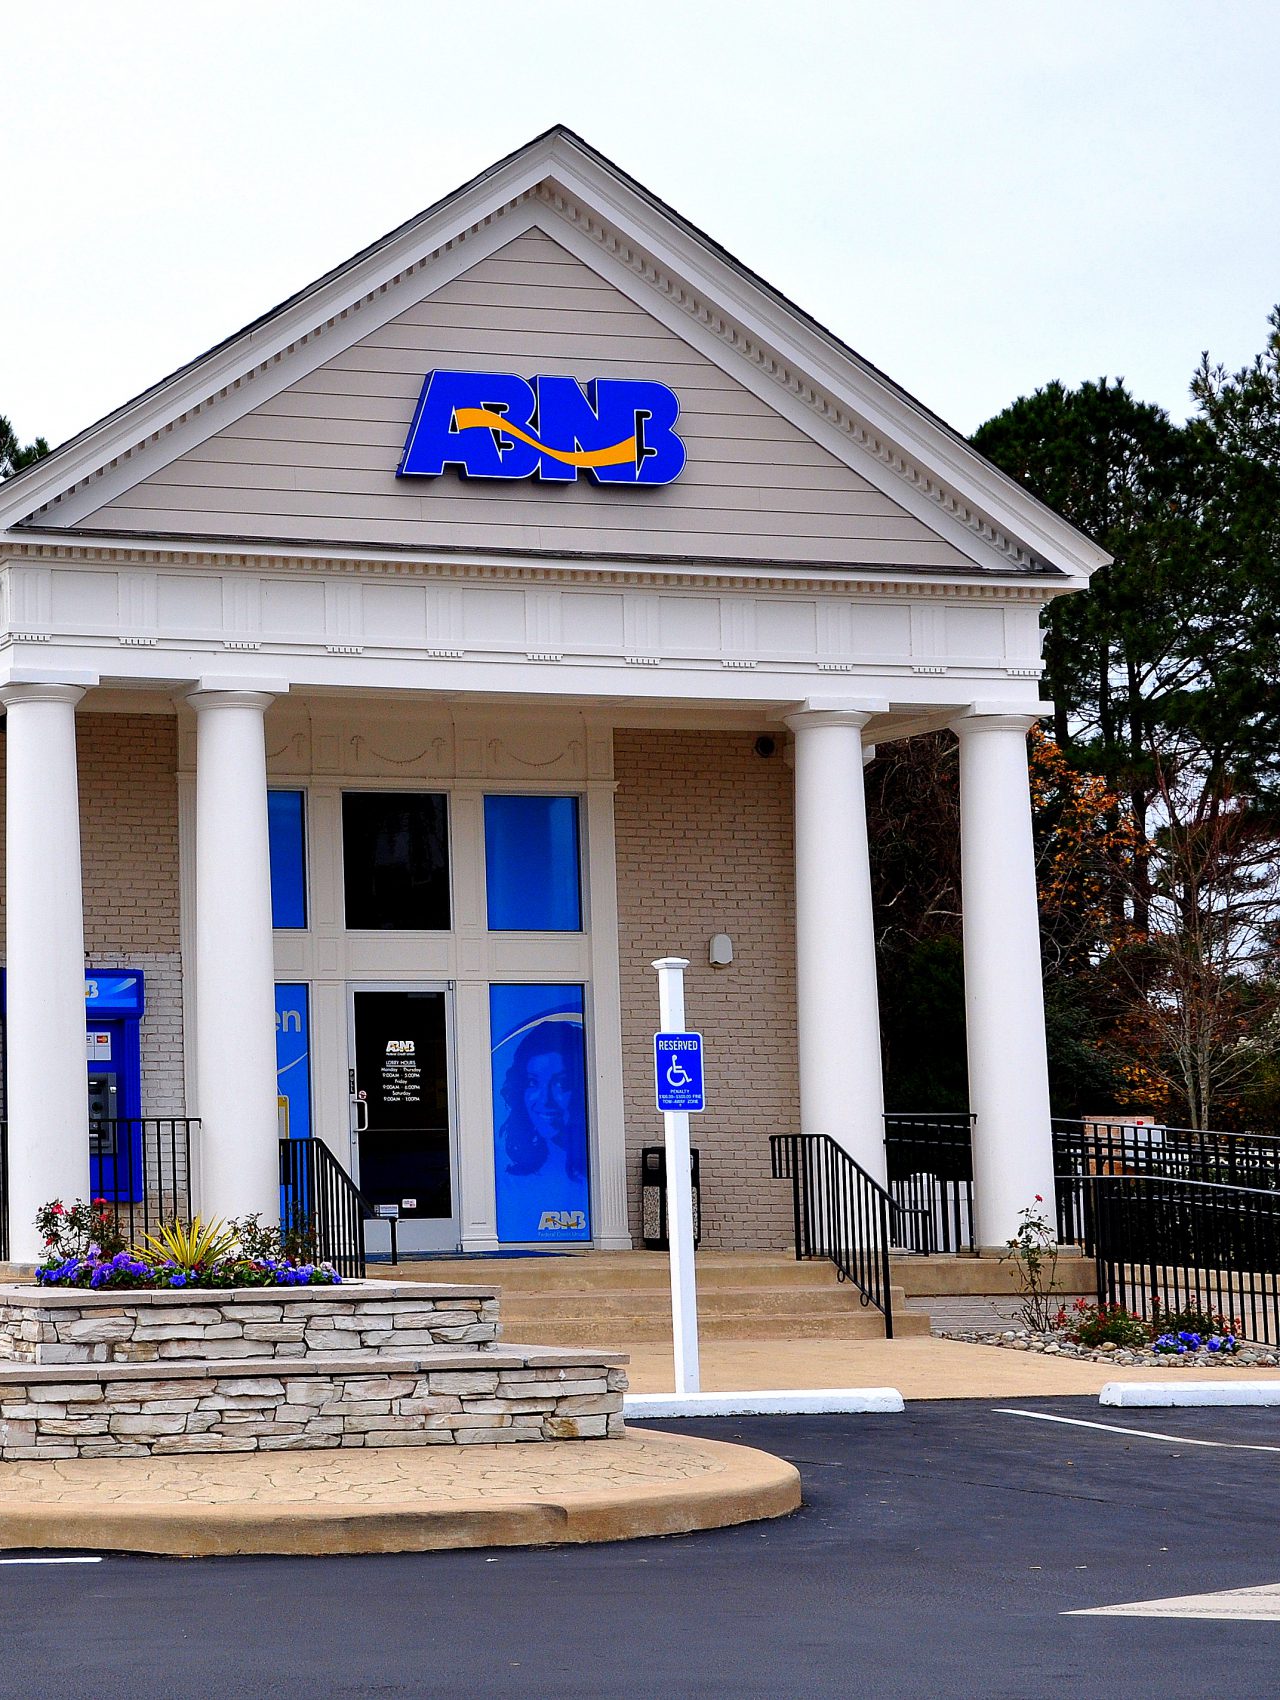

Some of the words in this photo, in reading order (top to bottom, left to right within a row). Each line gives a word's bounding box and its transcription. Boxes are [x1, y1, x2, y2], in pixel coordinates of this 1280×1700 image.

[397, 368, 688, 486] ABNB
[385, 1041, 415, 1052] ABNB
[658, 1040, 698, 1051] RESERVED
[538, 1211, 586, 1230] ABNB
